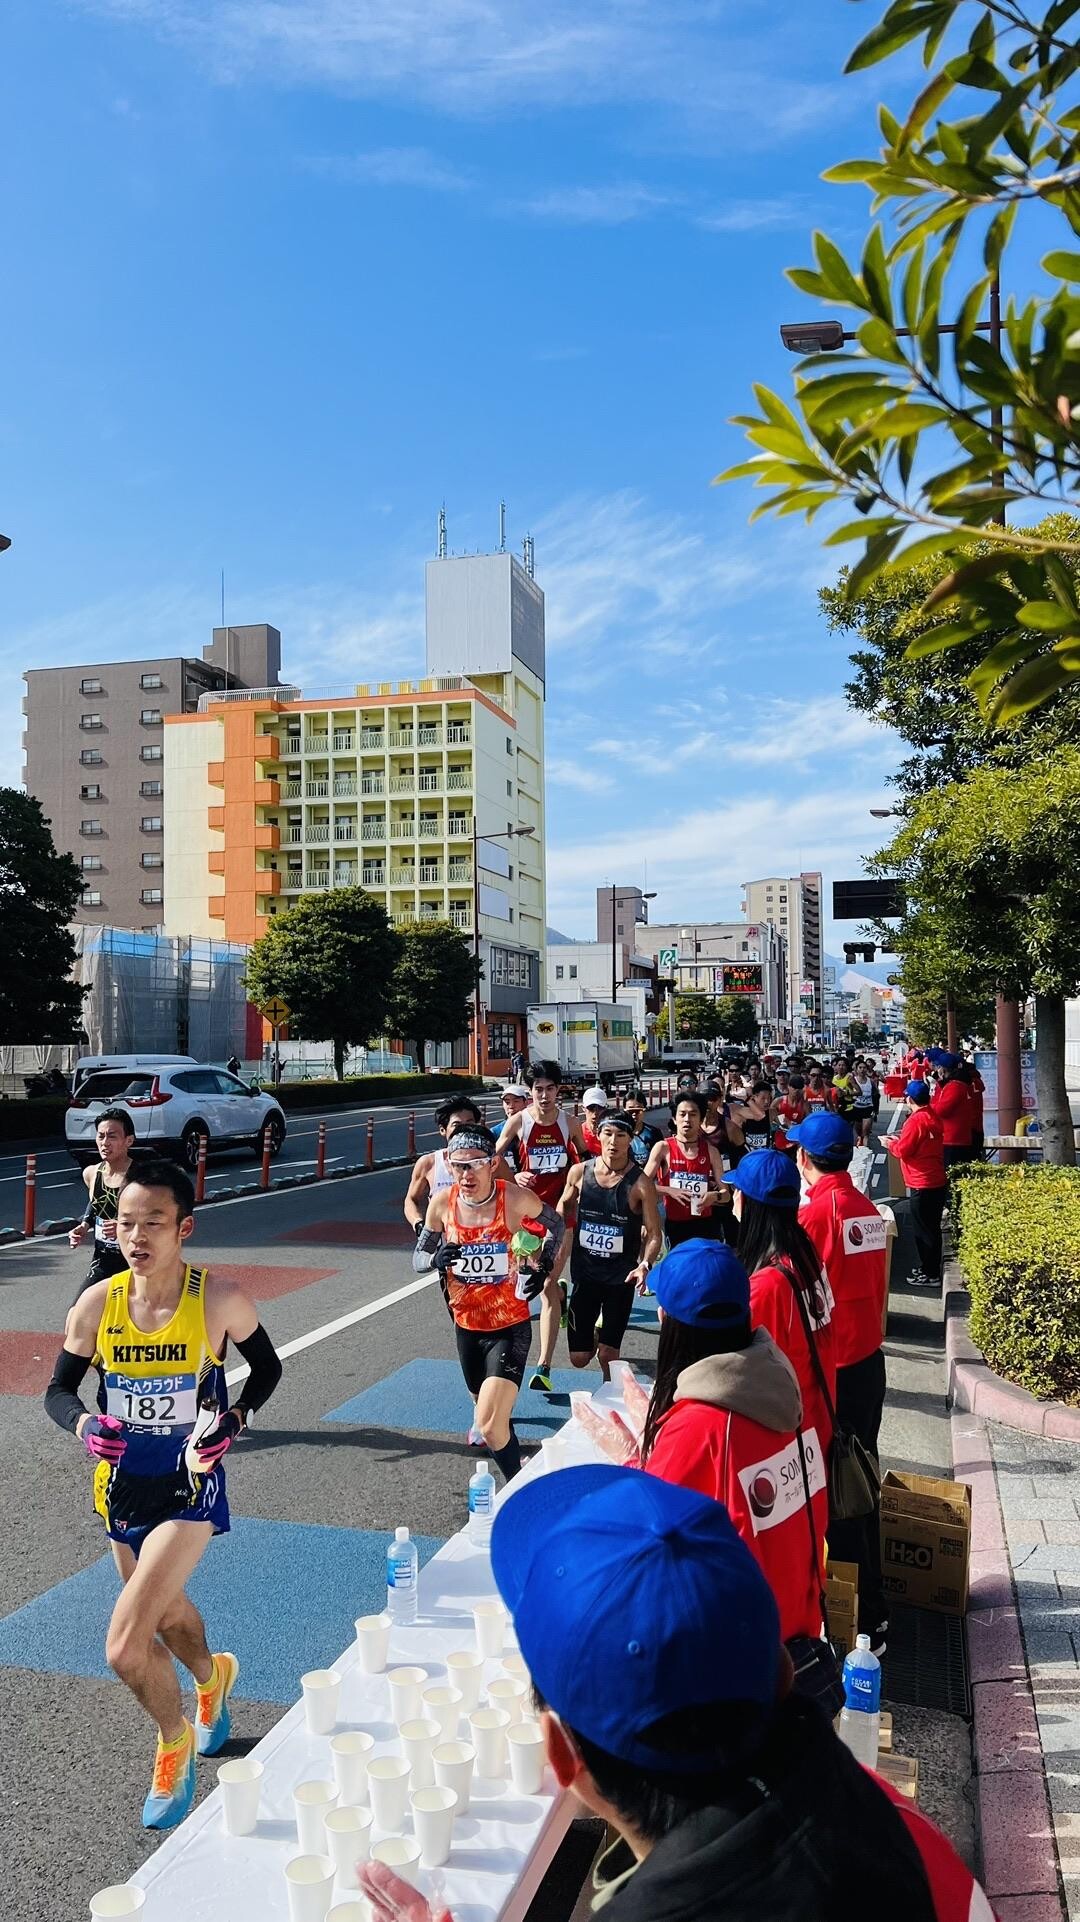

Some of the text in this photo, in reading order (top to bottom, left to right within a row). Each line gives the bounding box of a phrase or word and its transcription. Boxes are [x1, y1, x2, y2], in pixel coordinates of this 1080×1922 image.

[537, 1154, 561, 1167] 717
[678, 1181, 701, 1193] 166
[460, 1244, 500, 1255] CAクラウド
[586, 1234, 614, 1250] 446
[460, 1256, 496, 1273] 202
[112, 1343, 188, 1363] KITSUKI
[116, 1376, 183, 1394] PCAクラウド
[124, 1394, 177, 1420] 182
[126, 1424, 172, 1436] ソニー生命
[780, 1445, 814, 1486] SOMO
[890, 1541, 932, 1567] H2O
